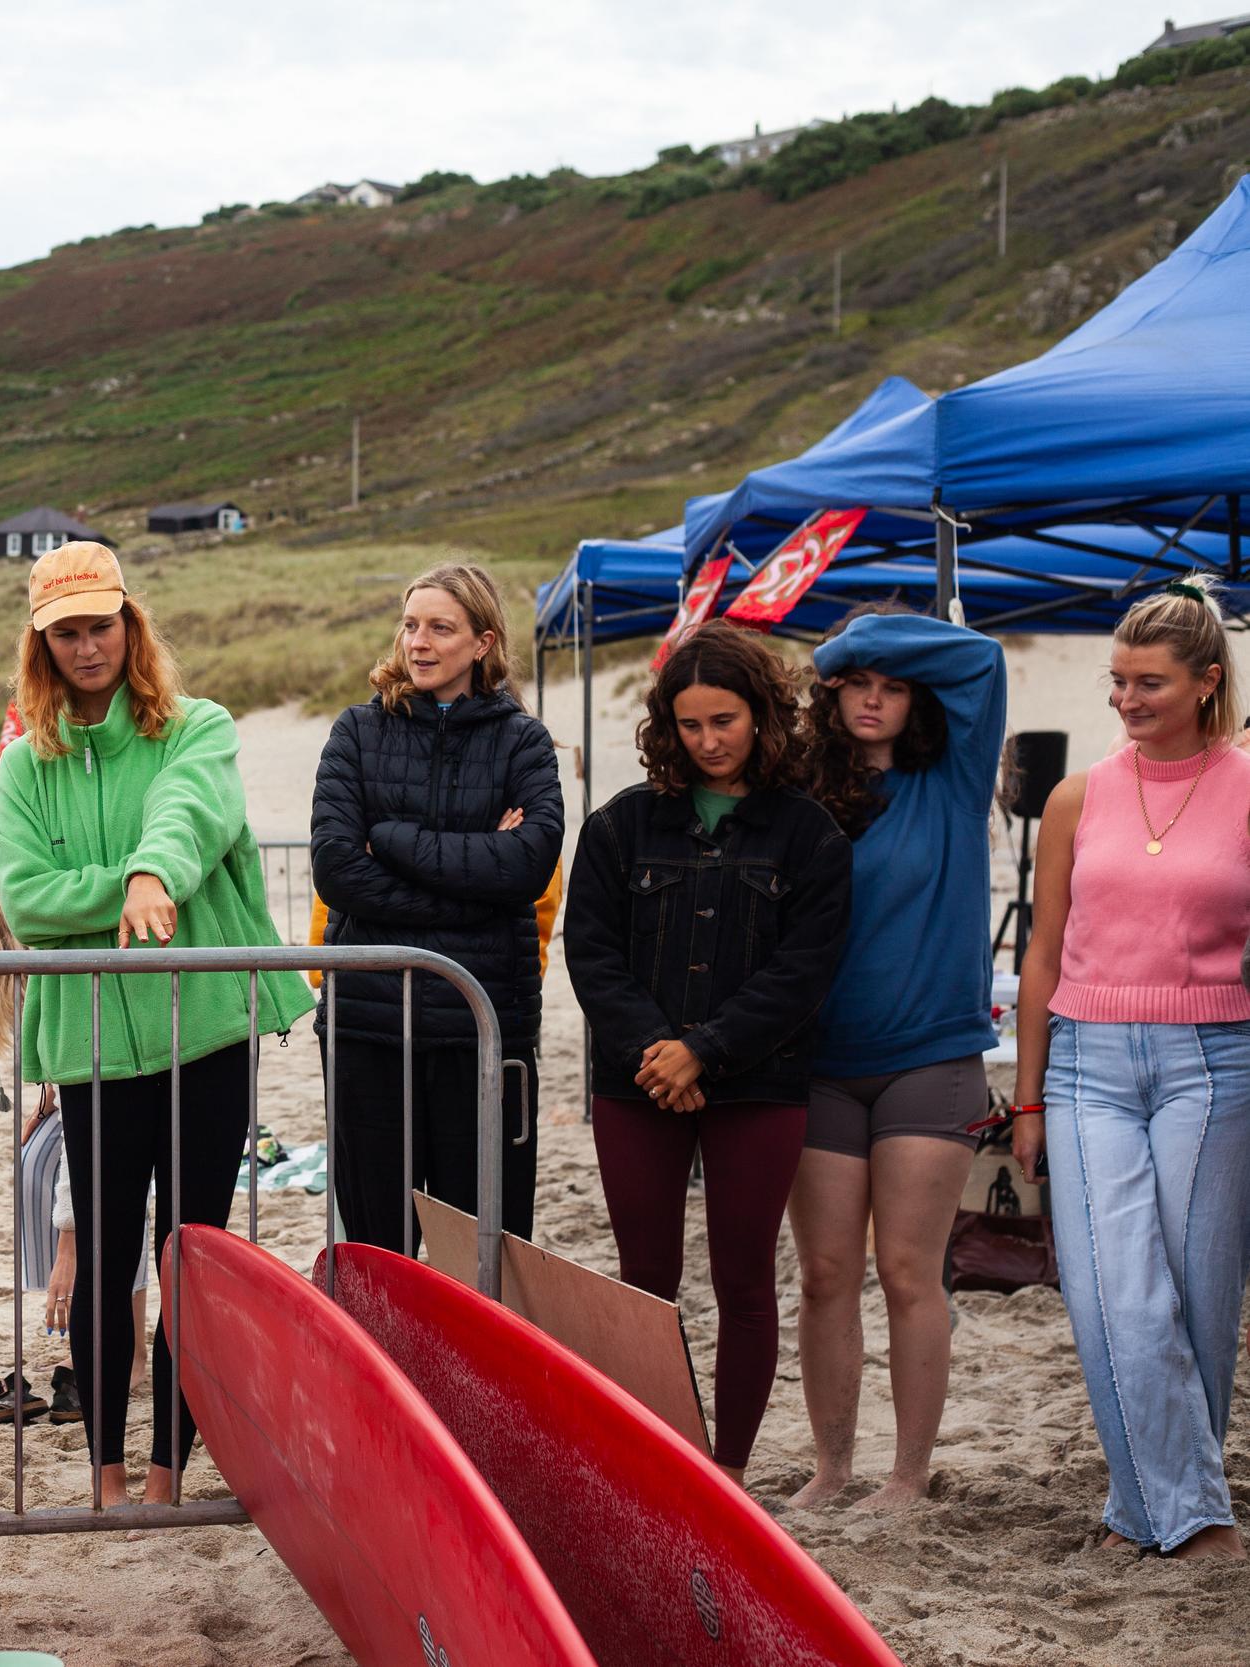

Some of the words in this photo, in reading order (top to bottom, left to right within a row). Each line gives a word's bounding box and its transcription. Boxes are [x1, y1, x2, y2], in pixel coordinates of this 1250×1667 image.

[43, 579, 54, 590] surf
[55, 575, 73, 586] birds
[74, 572, 98, 581] festival
